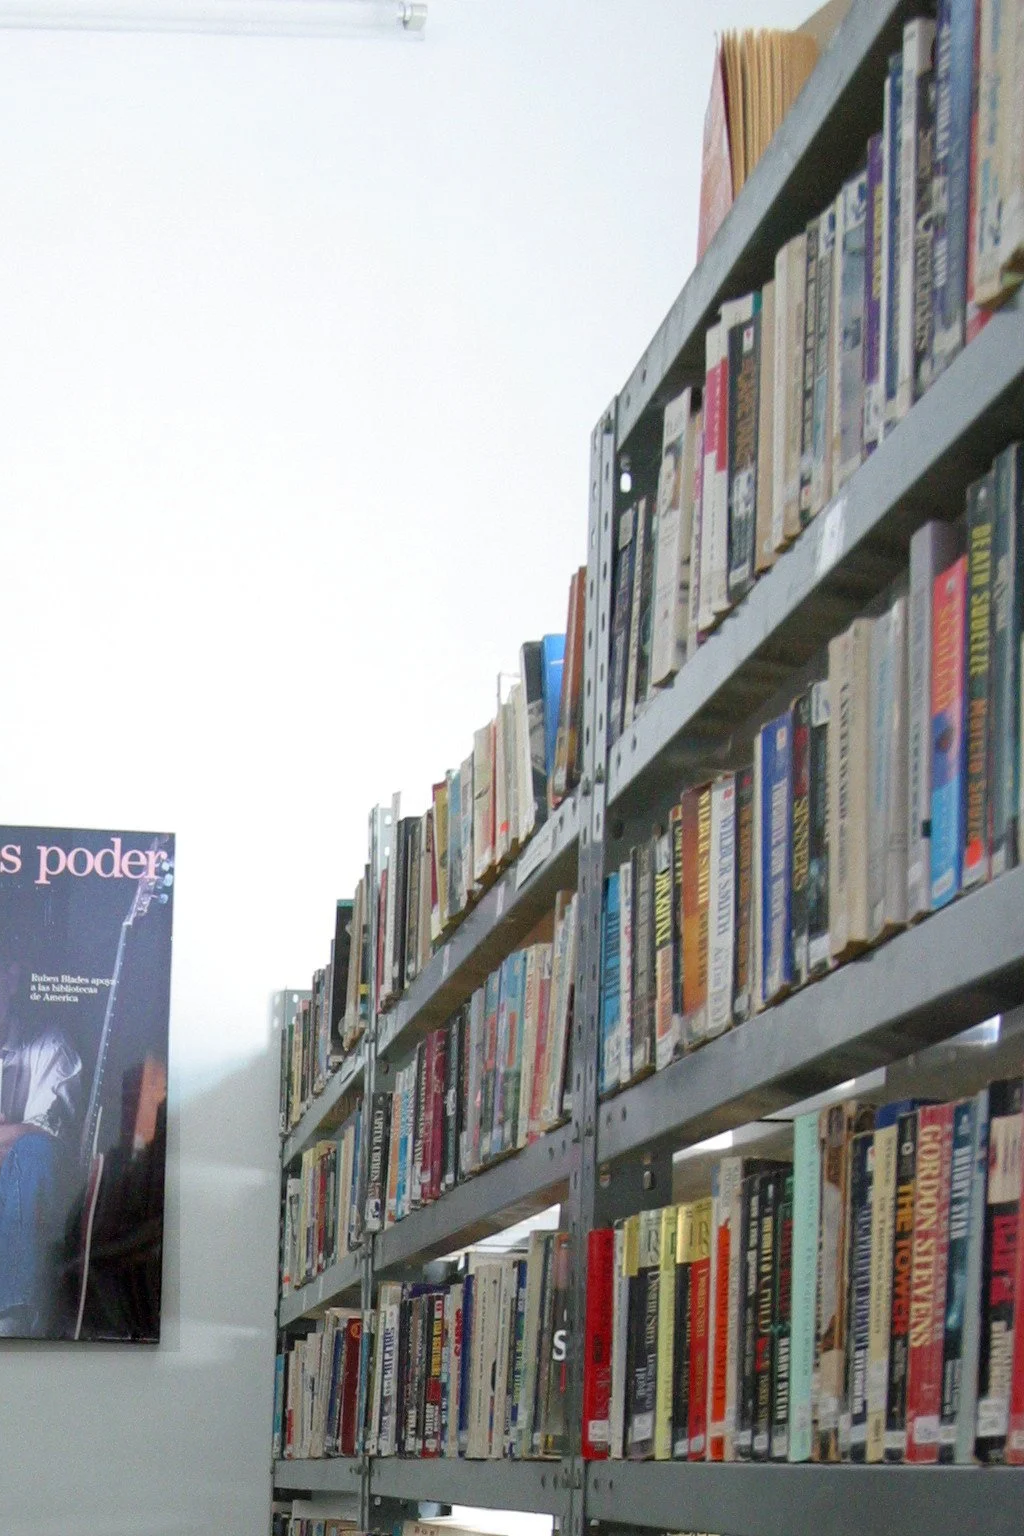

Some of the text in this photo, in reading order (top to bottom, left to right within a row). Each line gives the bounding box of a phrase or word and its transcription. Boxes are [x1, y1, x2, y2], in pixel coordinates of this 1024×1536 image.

[34, 837, 168, 884] poder
[717, 815, 733, 936] WILBUR SMITH
[29, 993, 41, 1001] de
[38, 983, 50, 992] las
[52, 984, 98, 994] bibliotecas
[61, 974, 89, 985] Blades
[909, 1125, 942, 1348] GORDON STEVENS
[892, 1182, 914, 1337] THE TOWER
[552, 1328, 567, 1362] S
[776, 1381, 788, 1420] STEIN
[425, 1403, 434, 1437] JUSTICE
